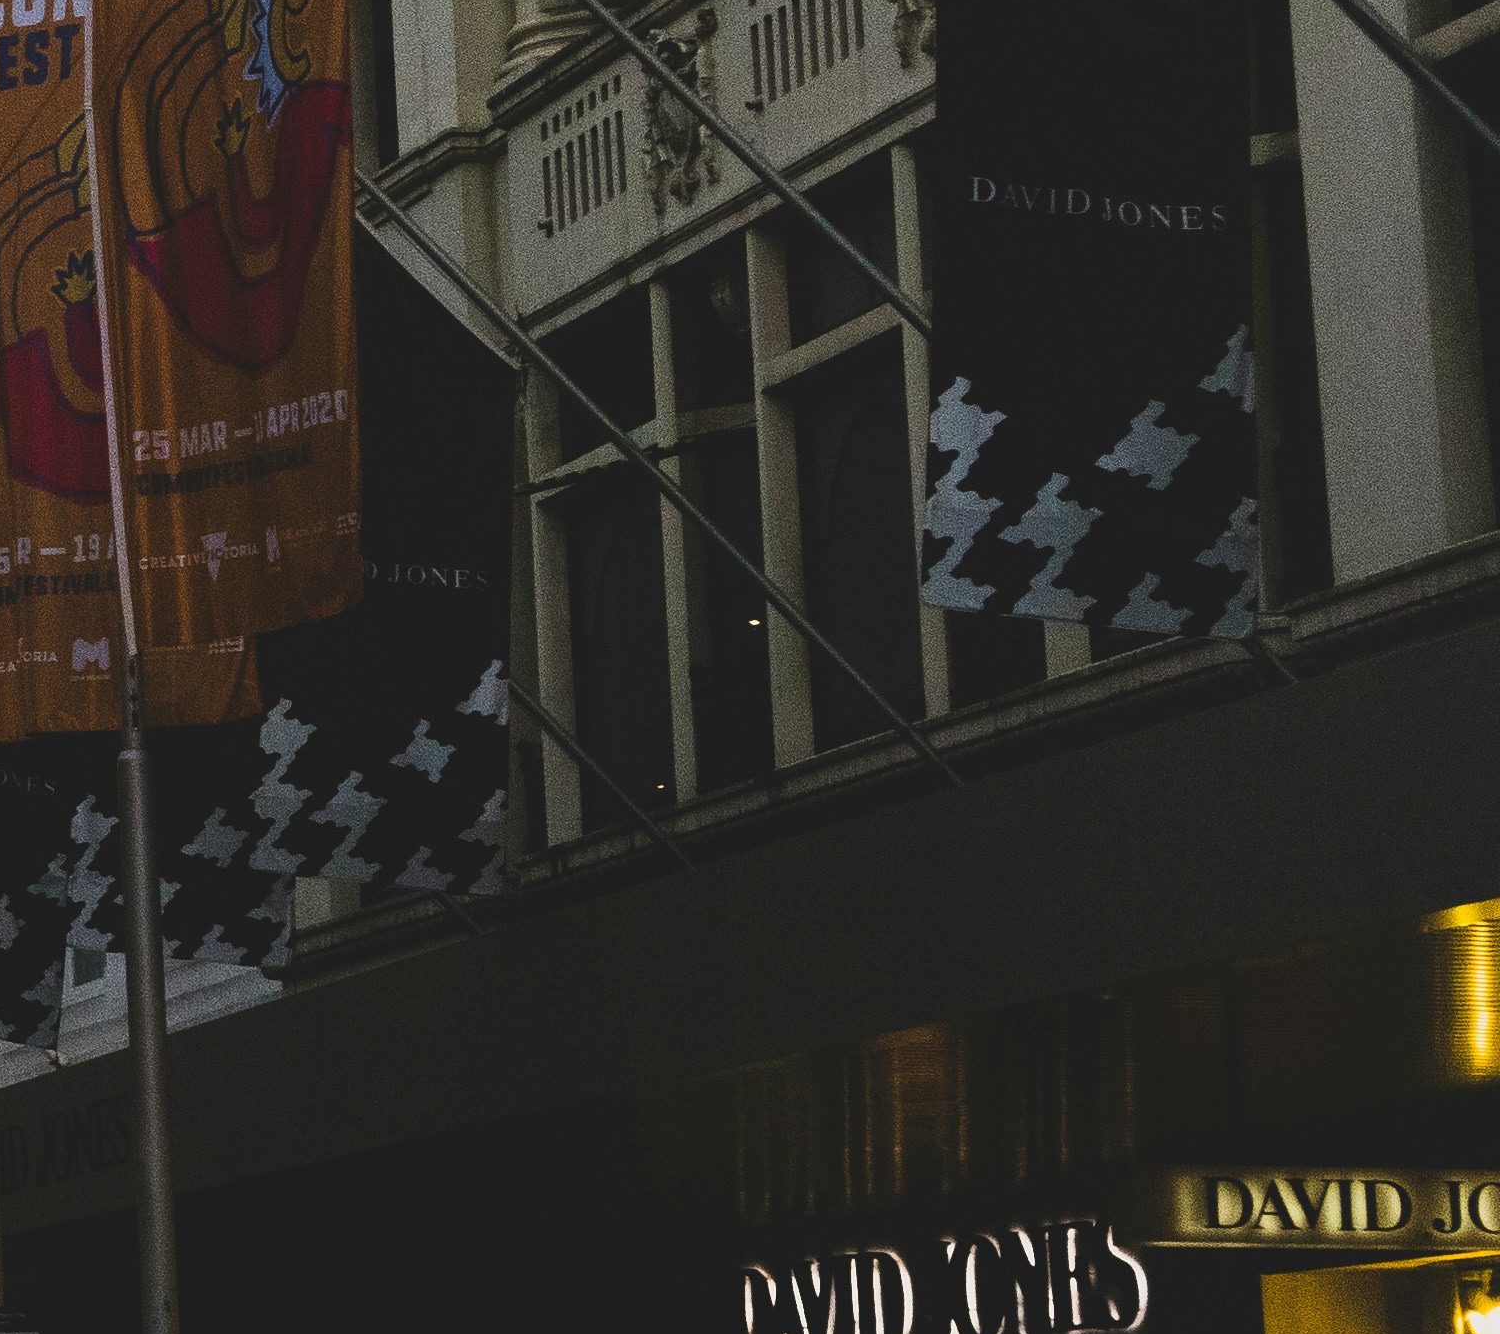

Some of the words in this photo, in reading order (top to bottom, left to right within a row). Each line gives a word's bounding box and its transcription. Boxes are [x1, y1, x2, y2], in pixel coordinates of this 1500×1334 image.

[970, 175, 1091, 215] DAVID
[1101, 196, 1226, 231] JONES
[133, 430, 171, 462] 25
[179, 420, 228, 458] MAR
[265, 406, 300, 440] APR
[73, 533, 99, 563] 19
[386, 561, 489, 593] JONES
[1202, 1176, 1411, 1231] DAVID
